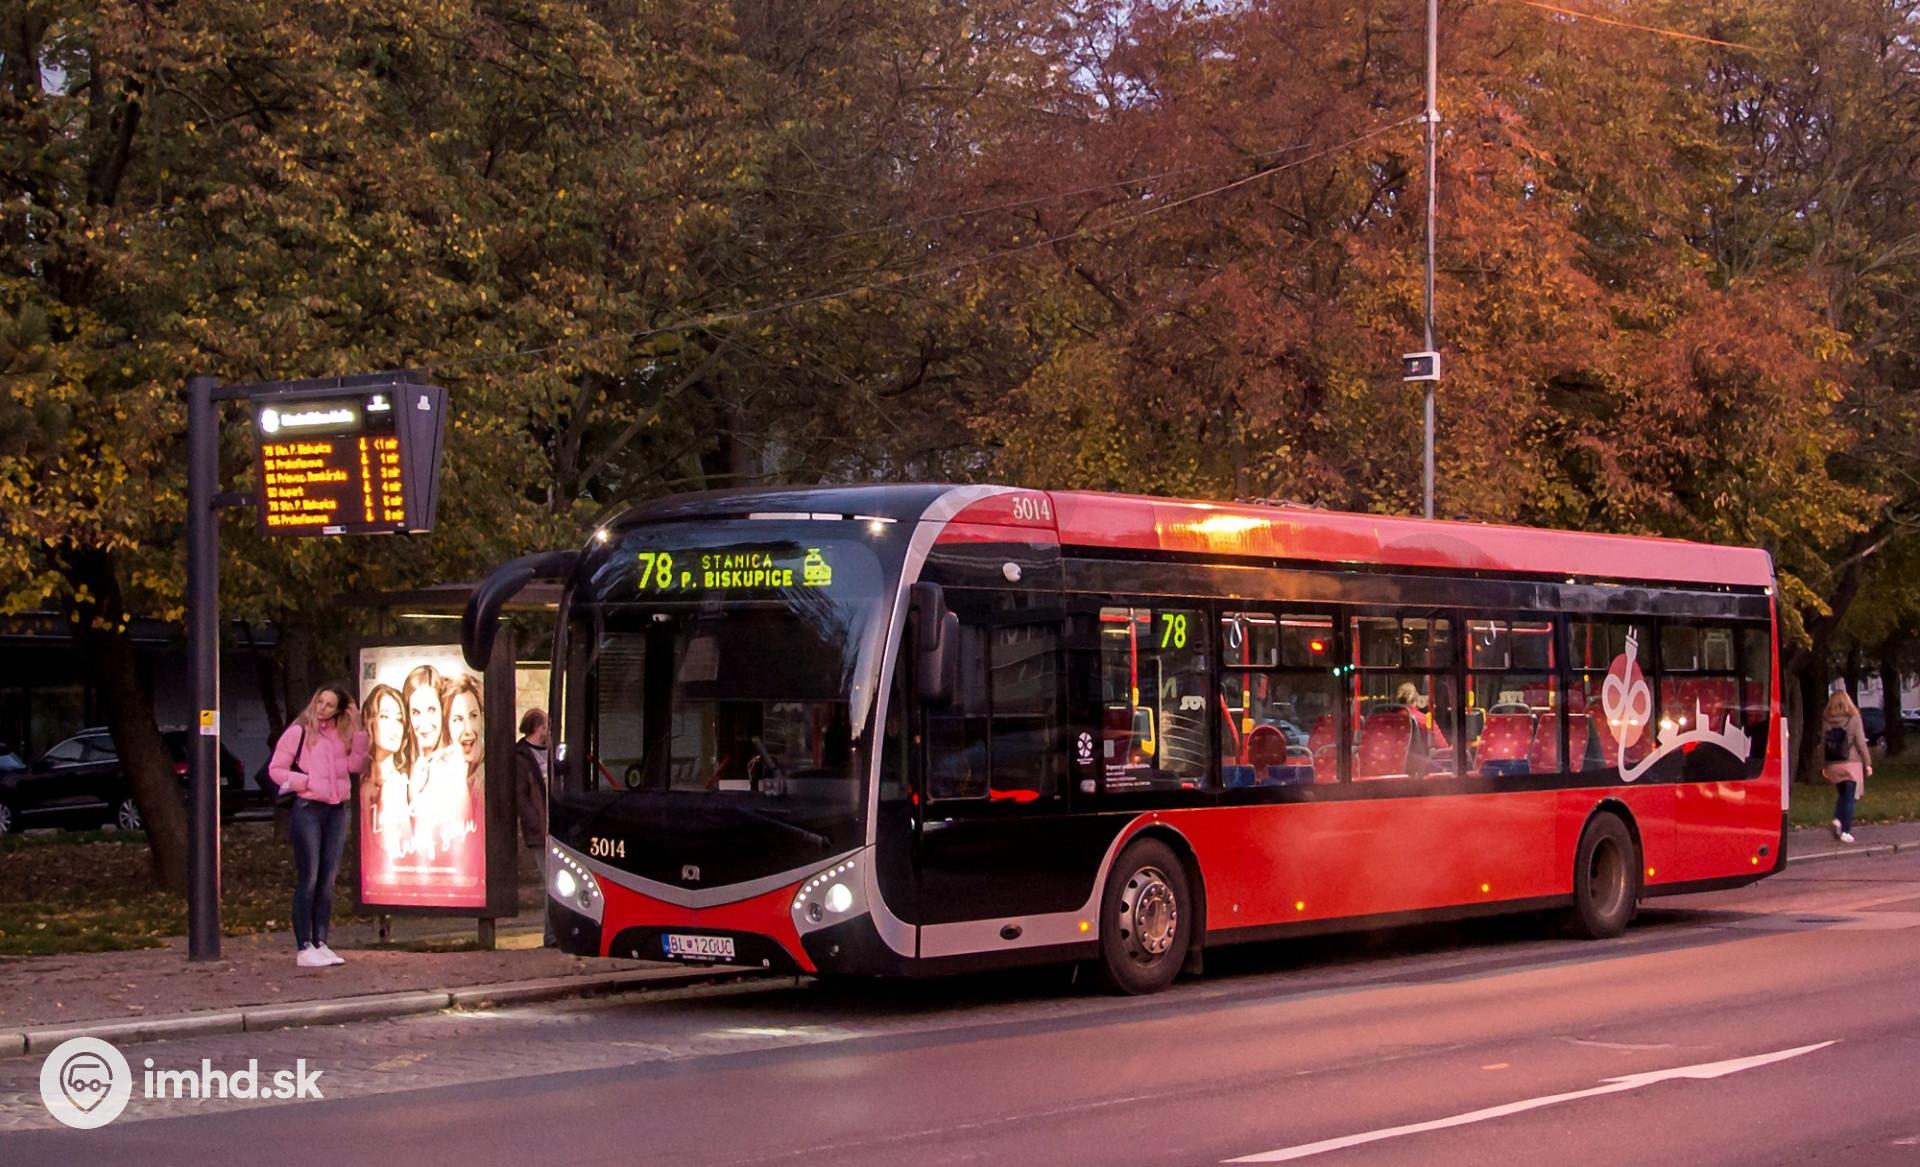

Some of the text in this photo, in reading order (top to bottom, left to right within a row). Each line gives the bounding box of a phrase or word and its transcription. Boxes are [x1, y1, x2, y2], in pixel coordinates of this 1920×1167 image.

[1012, 497, 1051, 520] 3014
[638, 552, 673, 589] 78
[701, 553, 773, 569] STANICA
[680, 569, 793, 588] P. BISKUPICE
[1160, 613, 1187, 648] 78
[590, 837, 626, 858] 3014
